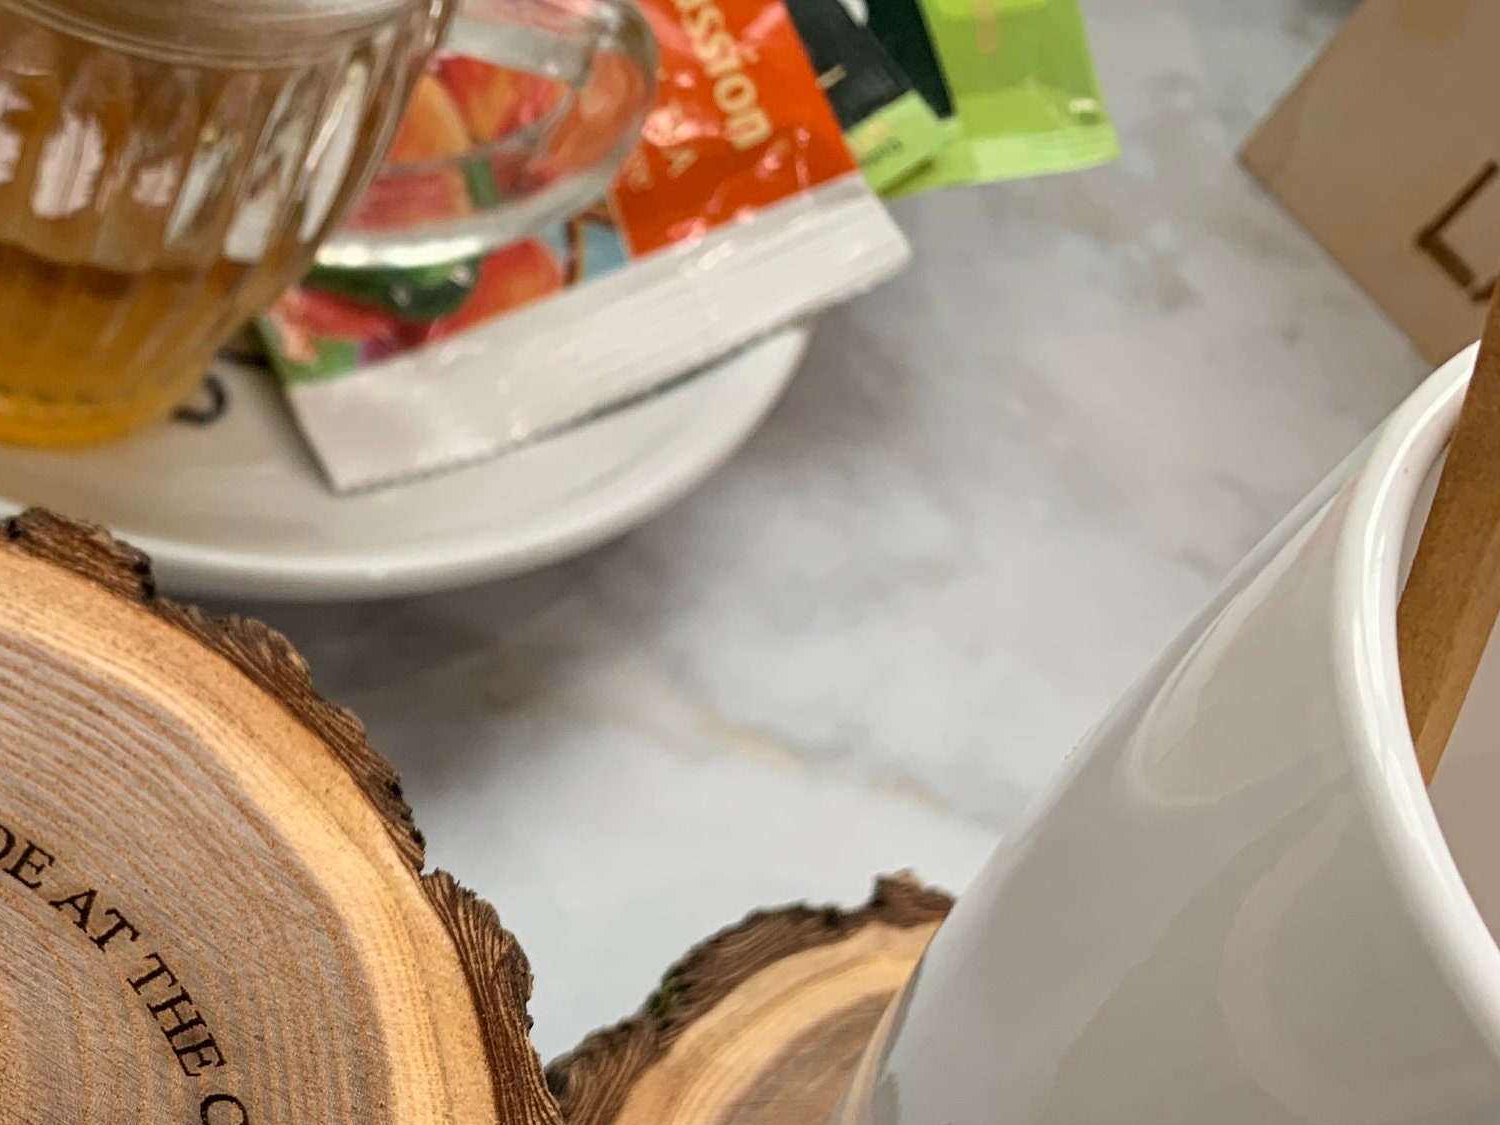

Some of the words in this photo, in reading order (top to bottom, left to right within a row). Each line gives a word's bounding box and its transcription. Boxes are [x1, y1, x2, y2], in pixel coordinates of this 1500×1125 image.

[674, 0, 771, 150] ssion
[49, 889, 140, 952] AT
[126, 953, 225, 1078] THE
